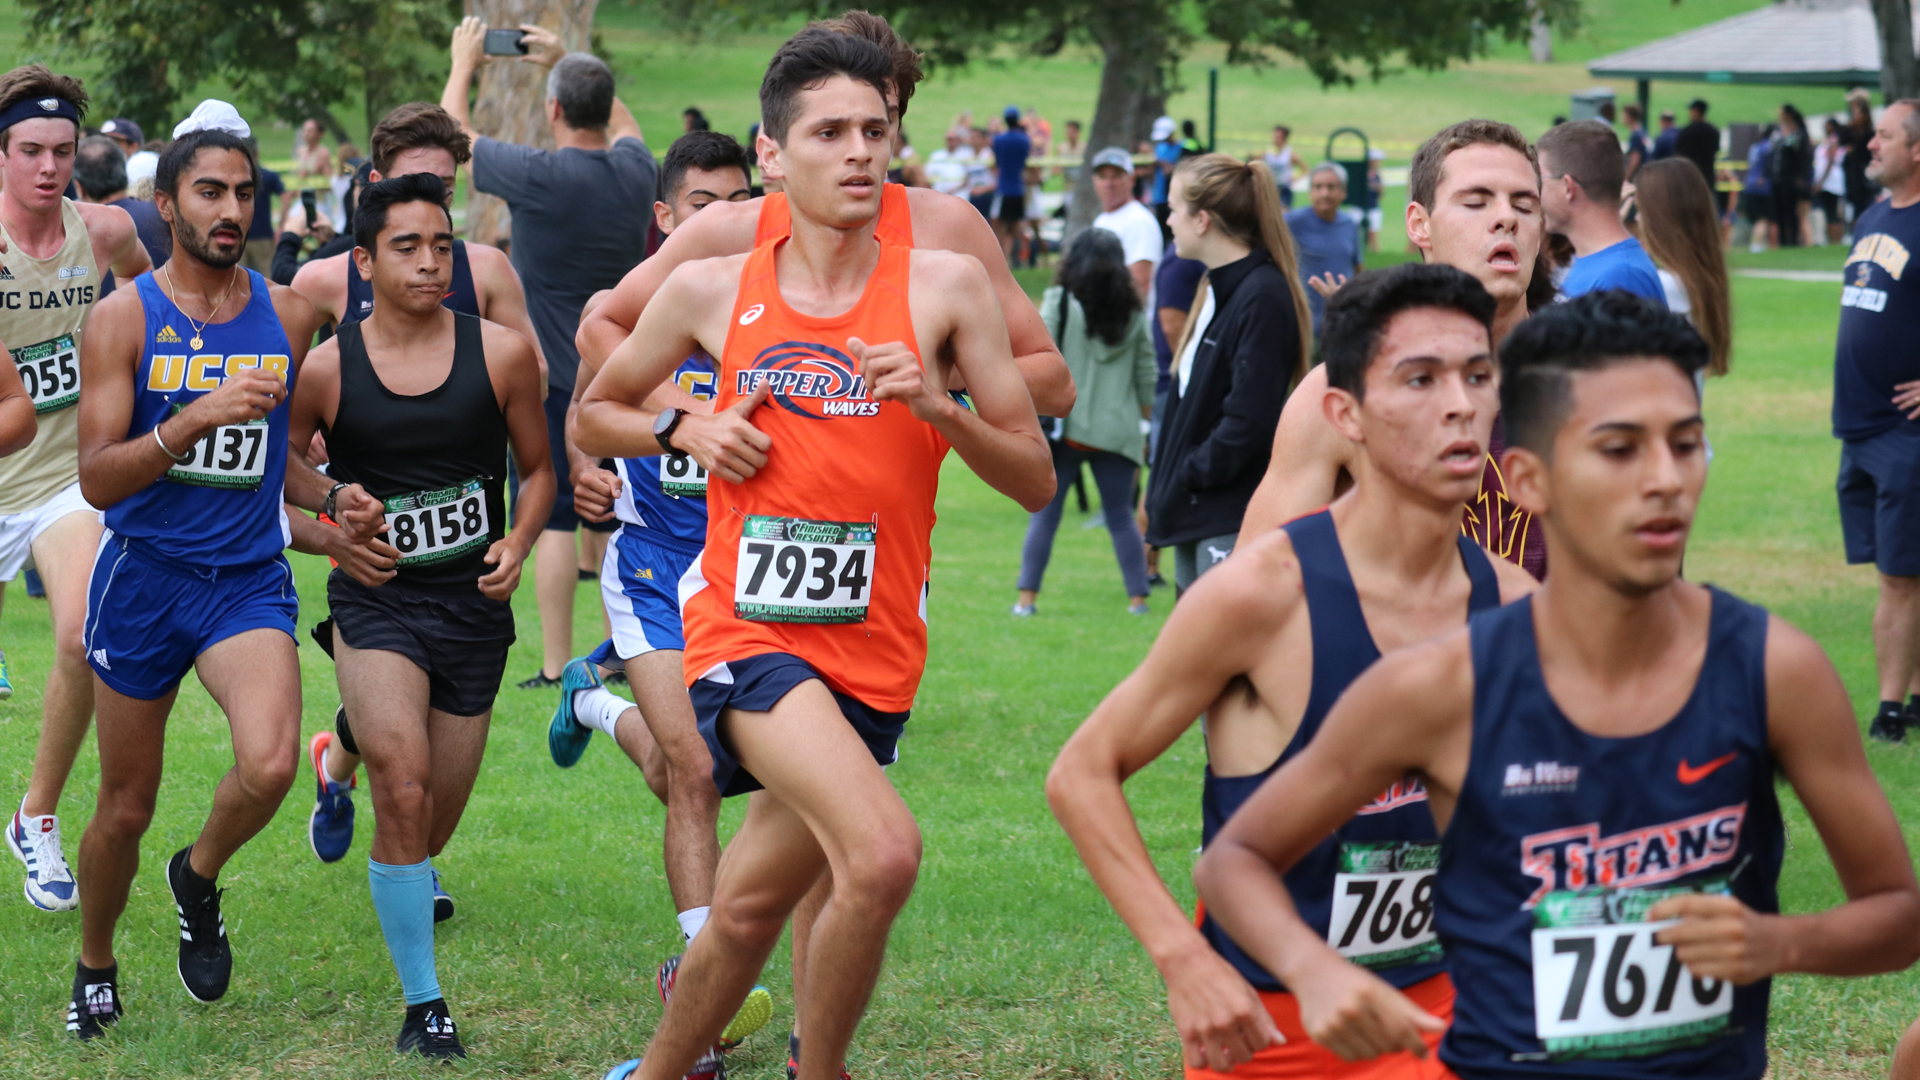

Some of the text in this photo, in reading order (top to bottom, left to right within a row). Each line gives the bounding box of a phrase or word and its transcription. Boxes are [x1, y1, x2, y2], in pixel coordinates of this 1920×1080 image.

[29, 286, 94, 310] DAVIS
[156, 335, 182, 343] adidas
[19, 352, 77, 401] 055
[822, 401, 880, 416] WAVES
[167, 469, 262, 484] WWW.FINISHEDRESULTS.COM
[425, 494, 457, 506] RESULTS
[426, 487, 457, 500] FINISHED
[394, 497, 482, 553] 8158
[800, 523, 840, 534] FINISHED
[795, 533, 837, 544] RESULTS
[744, 542, 868, 601] 7934
[739, 602, 866, 617] WWW.FINISHEDRESULTS.COM
[1338, 874, 1437, 948] 768
